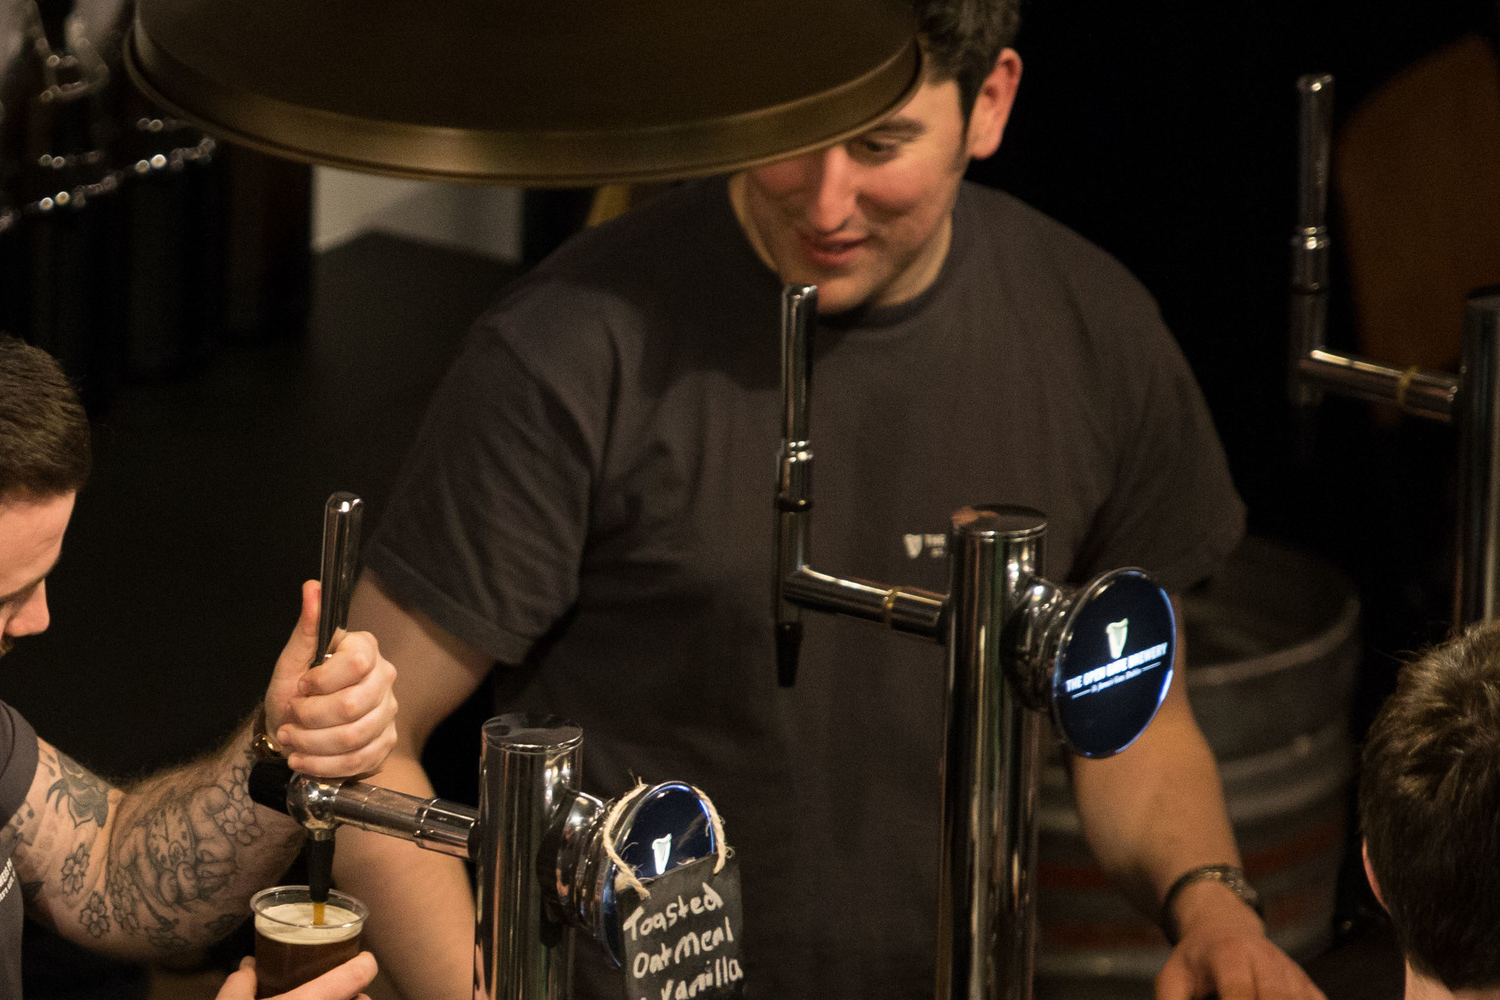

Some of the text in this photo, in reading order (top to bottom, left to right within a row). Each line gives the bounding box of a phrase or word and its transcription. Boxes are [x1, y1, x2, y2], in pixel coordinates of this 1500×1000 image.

[1066, 675, 1083, 693] THE
[1083, 666, 1106, 686] OPEN
[1127, 642, 1168, 669] BREWERY
[623, 882, 725, 942] Toasted
